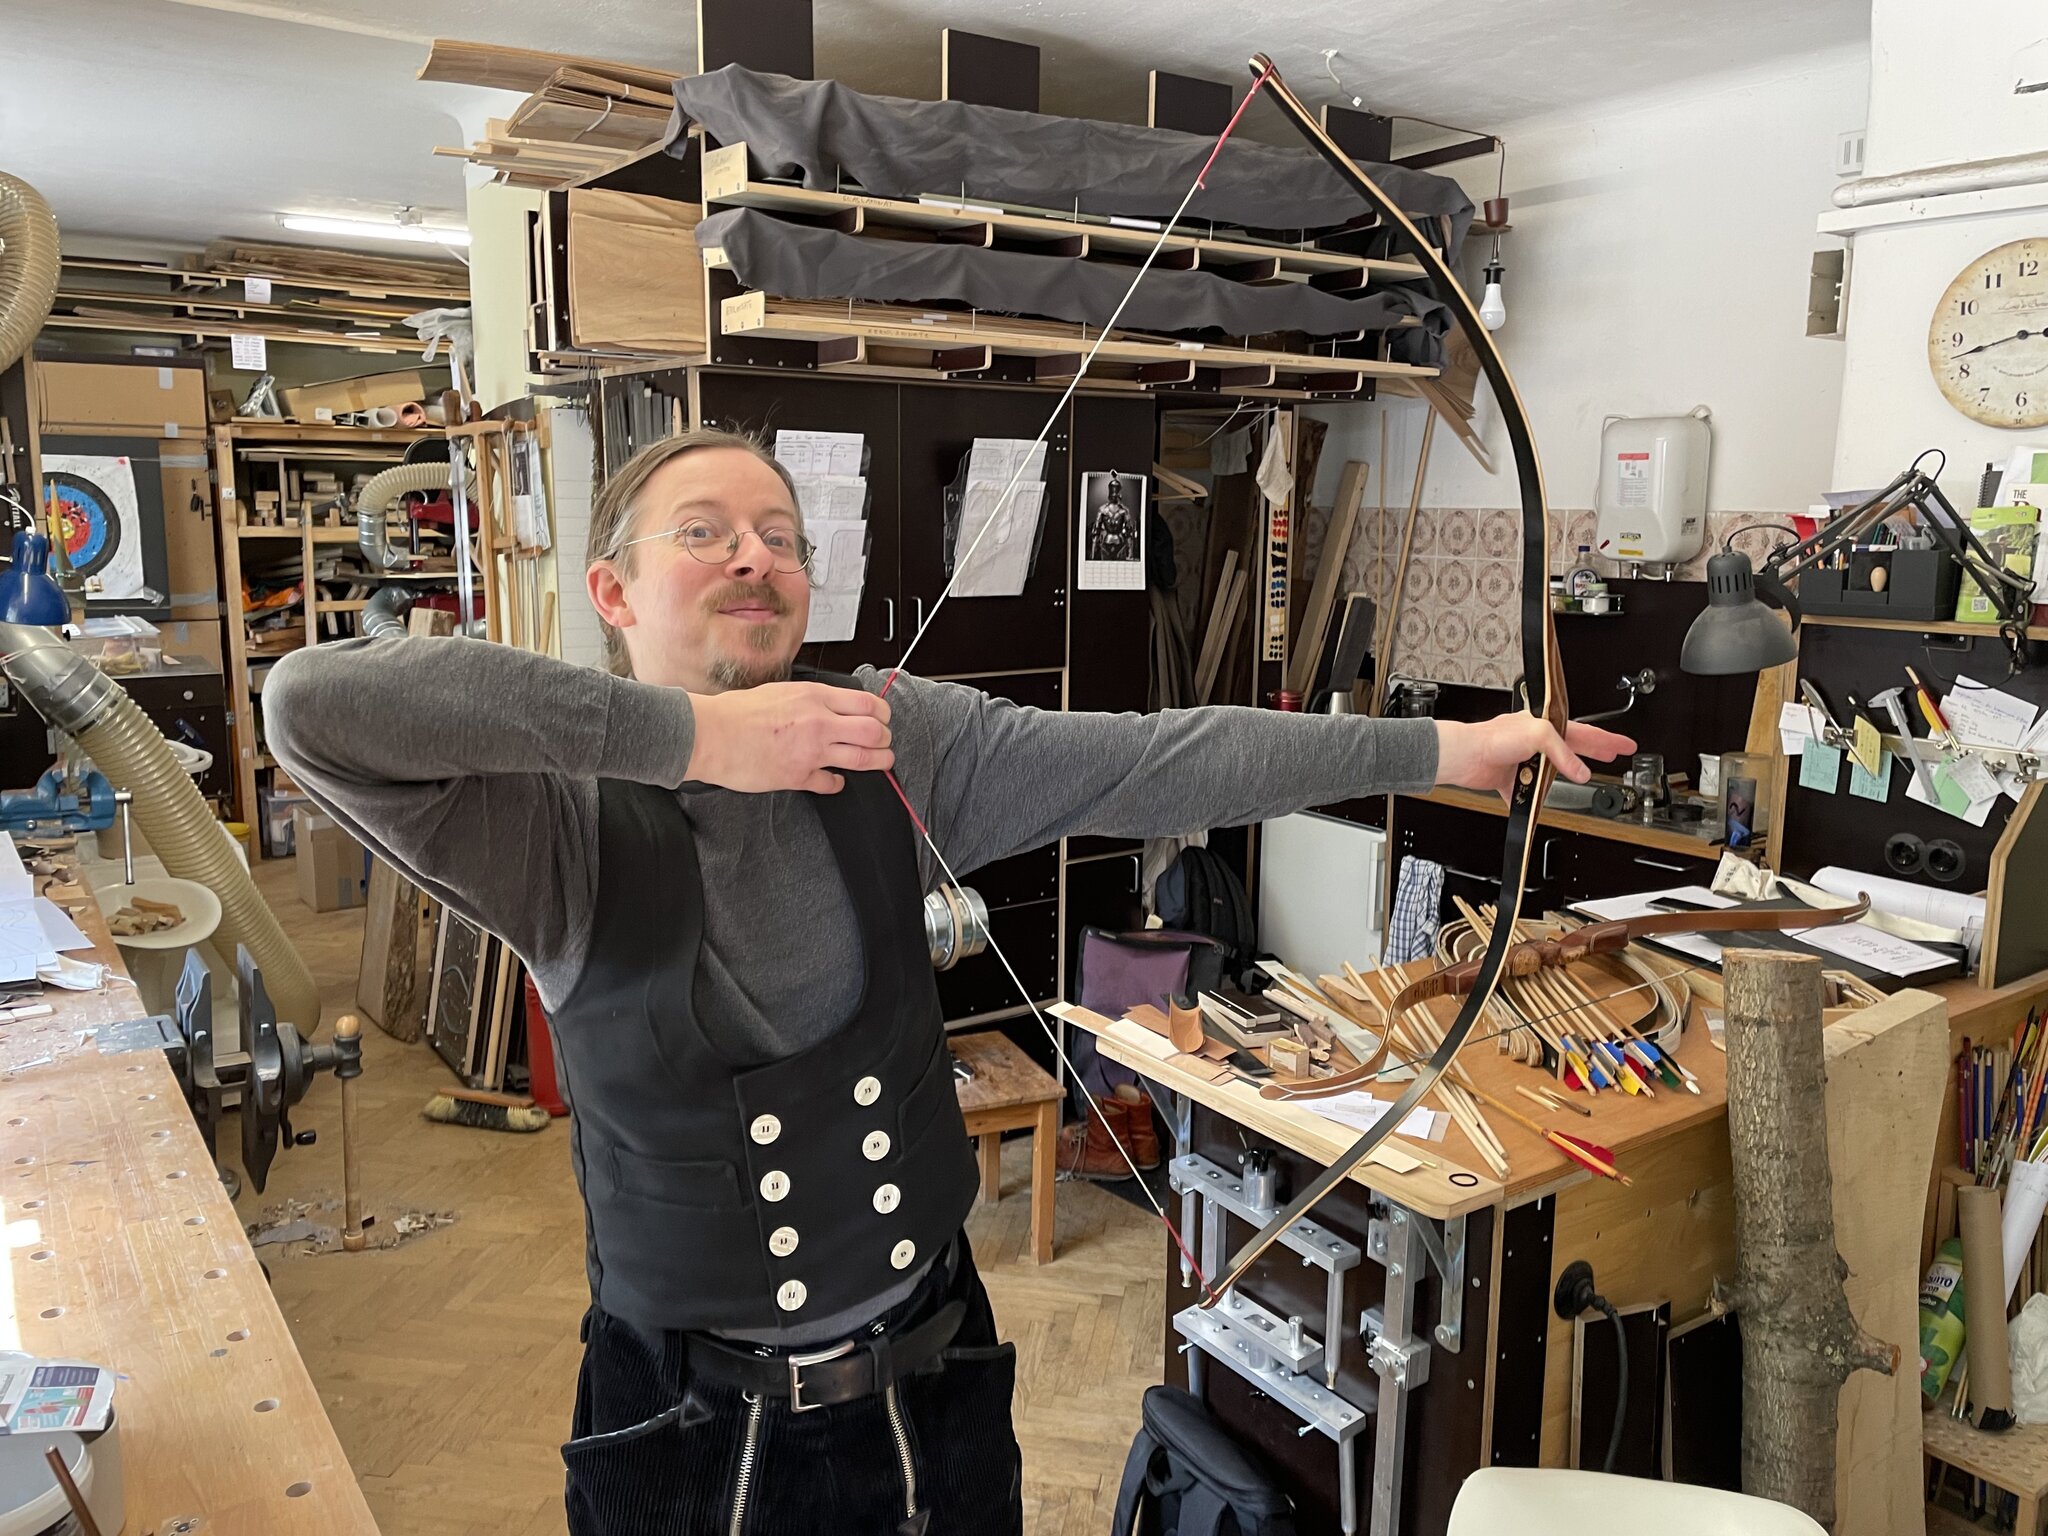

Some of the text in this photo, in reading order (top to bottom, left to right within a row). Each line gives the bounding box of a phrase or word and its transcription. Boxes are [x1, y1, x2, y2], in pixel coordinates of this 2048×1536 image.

[2019, 260, 2039, 277] 12
[1985, 273, 2002, 289] 11
[1960, 299, 1980, 316] 10
[1952, 332, 1964, 348] 9
[1959, 363, 1970, 379] 8
[1980, 387, 1991, 402] 7
[2015, 391, 2028, 407] 6
[2013, 489, 2028, 499] THE
